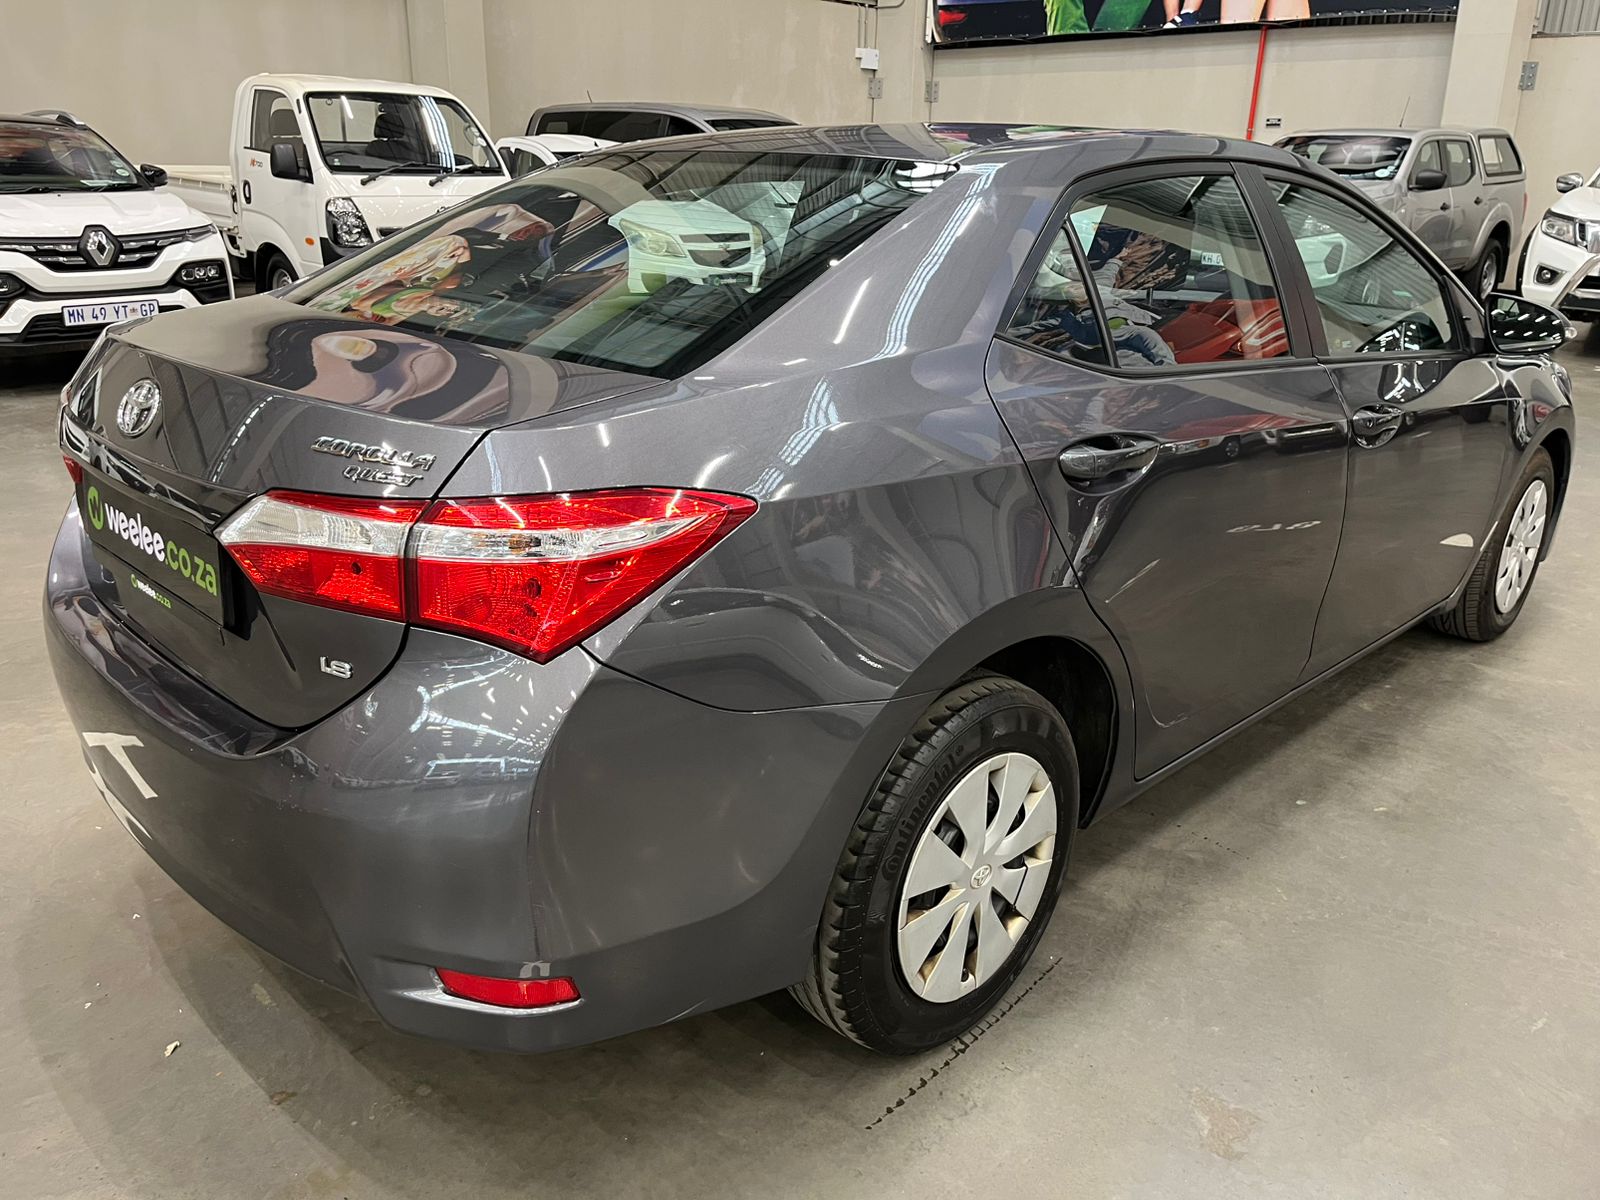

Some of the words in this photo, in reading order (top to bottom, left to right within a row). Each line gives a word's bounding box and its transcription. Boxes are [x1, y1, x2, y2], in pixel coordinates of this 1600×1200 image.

[67, 308, 85, 323] MN
[91, 306, 107, 321] 49
[113, 304, 129, 319] YT
[140, 303, 156, 317] GP
[310, 436, 437, 471] COROLLA
[342, 464, 424, 487] QUEST
[104, 502, 218, 597] weelee.co.za
[881, 753, 957, 882] Continental
